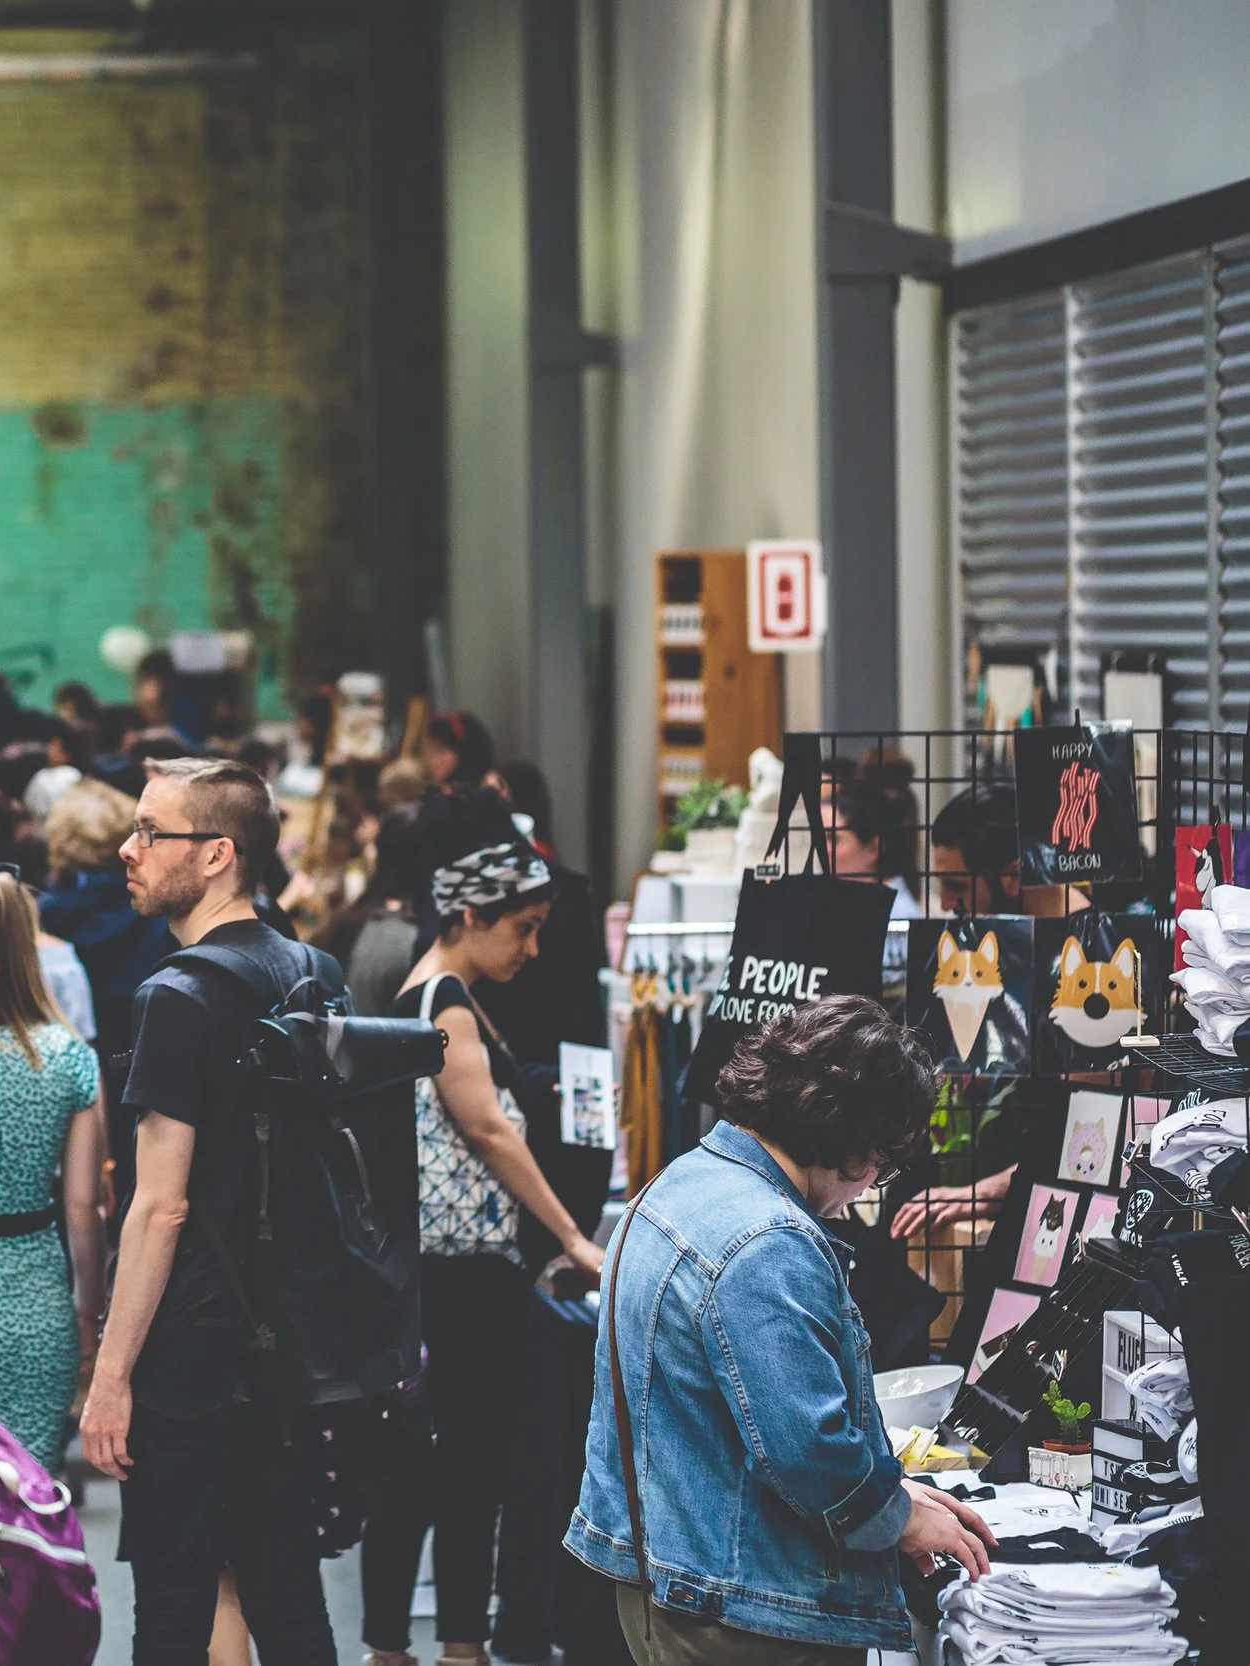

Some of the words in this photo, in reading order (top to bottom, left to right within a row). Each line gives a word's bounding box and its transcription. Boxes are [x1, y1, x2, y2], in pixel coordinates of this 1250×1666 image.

[1052, 743, 1094, 761] HAPPY
[1058, 853, 1101, 872] BACON
[739, 955, 829, 1001] PEOPLE
[720, 996, 756, 1024] LOVE
